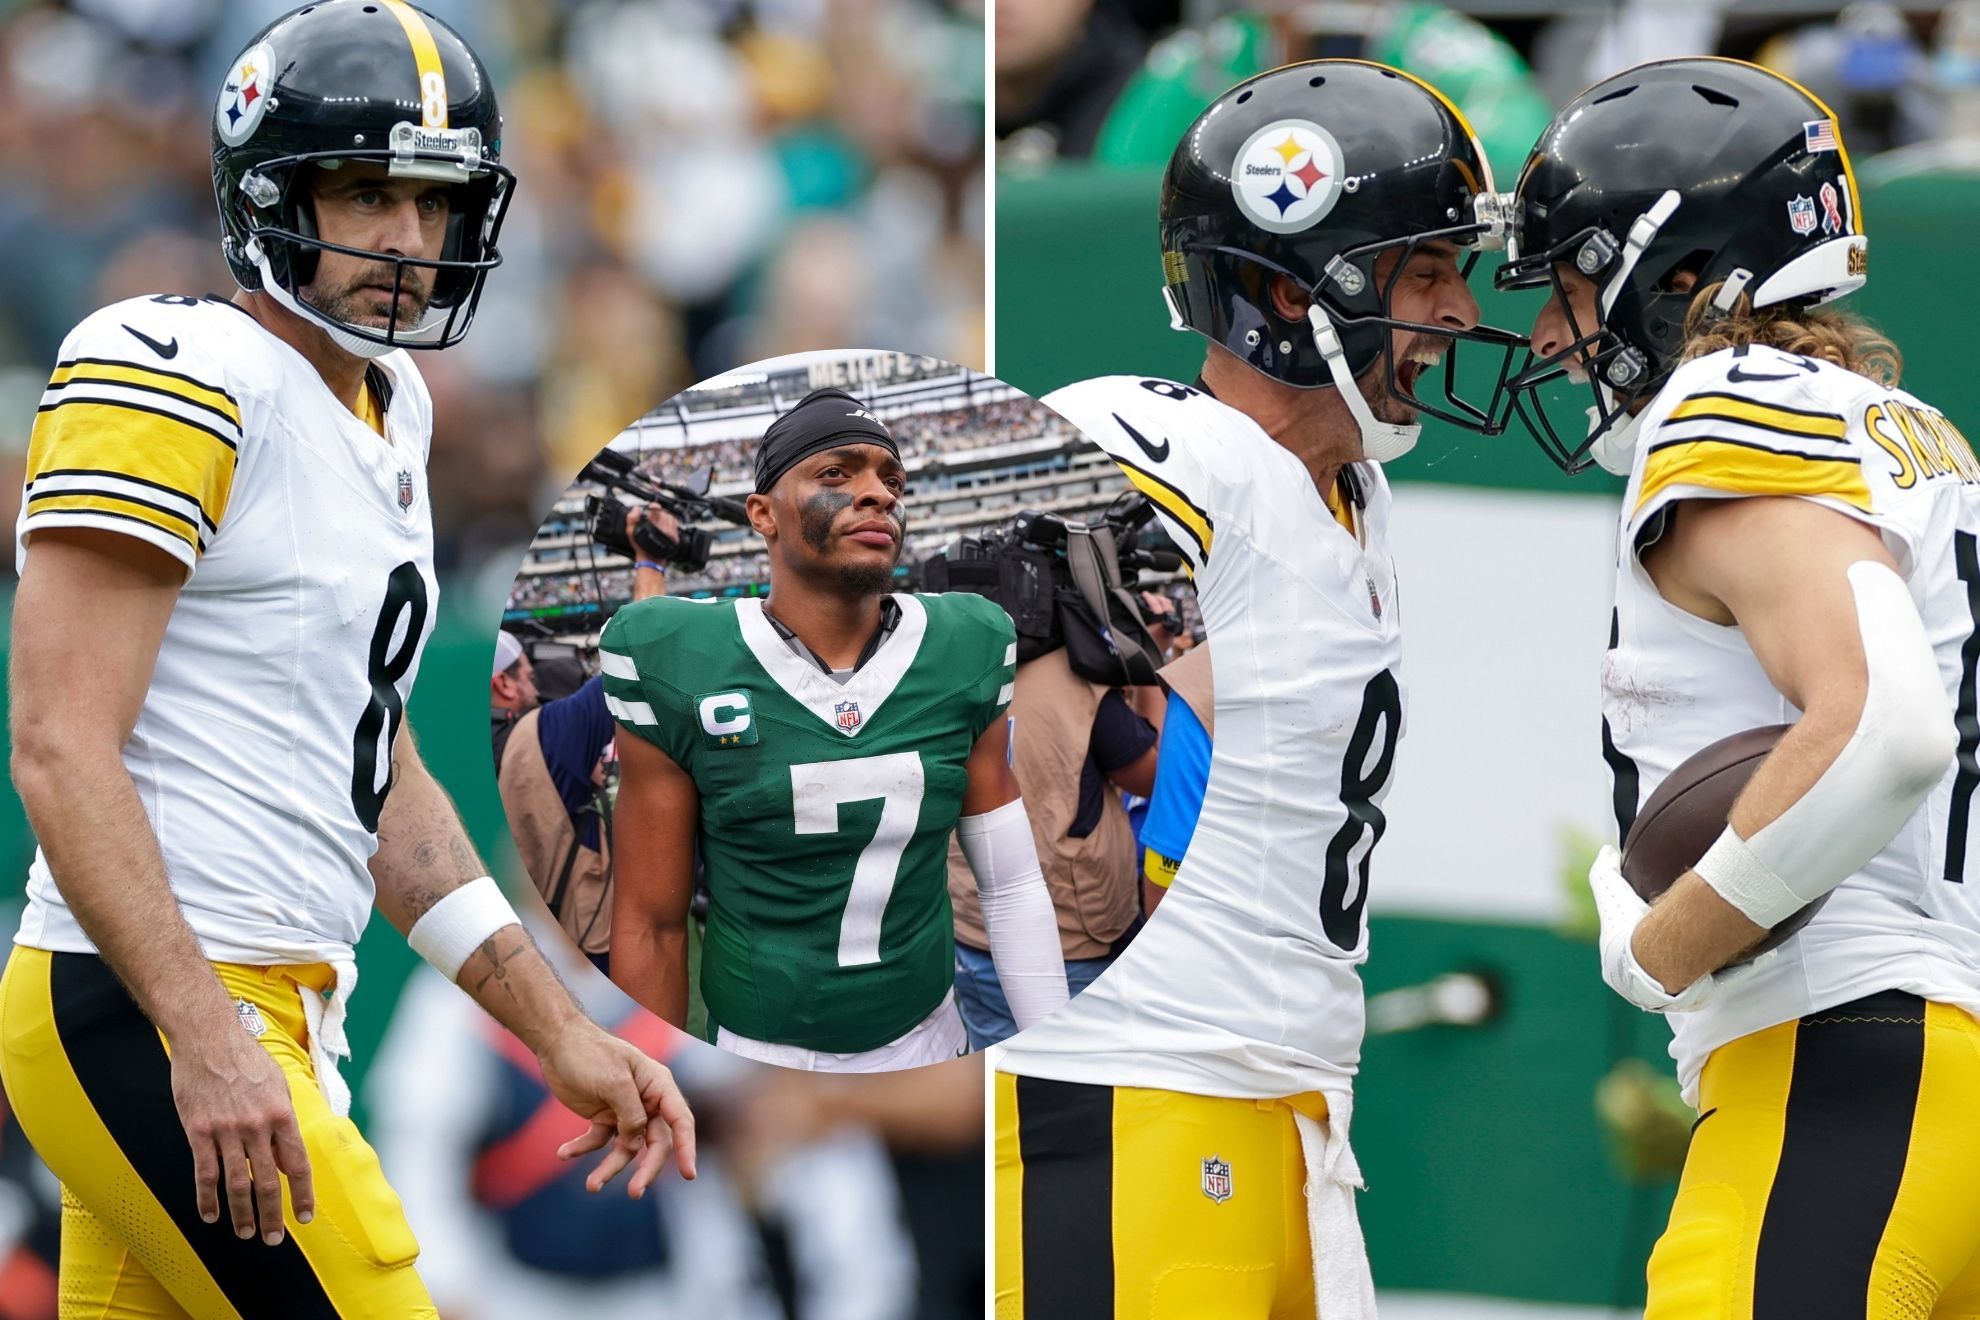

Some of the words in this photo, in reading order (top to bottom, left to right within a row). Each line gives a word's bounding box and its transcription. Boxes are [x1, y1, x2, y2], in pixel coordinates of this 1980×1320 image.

[421, 72, 447, 127] 8
[415, 131, 457, 150] Steelers
[1246, 164, 1281, 176] Steelers
[1793, 212, 1815, 229] NFL
[807, 352, 914, 390] METLIFE
[351, 561, 428, 833] 8
[699, 692, 751, 736] C
[839, 712, 859, 727] NFL
[1320, 668, 1402, 951] 8
[790, 751, 925, 967] 7
[1208, 1175, 1230, 1194] NFL
